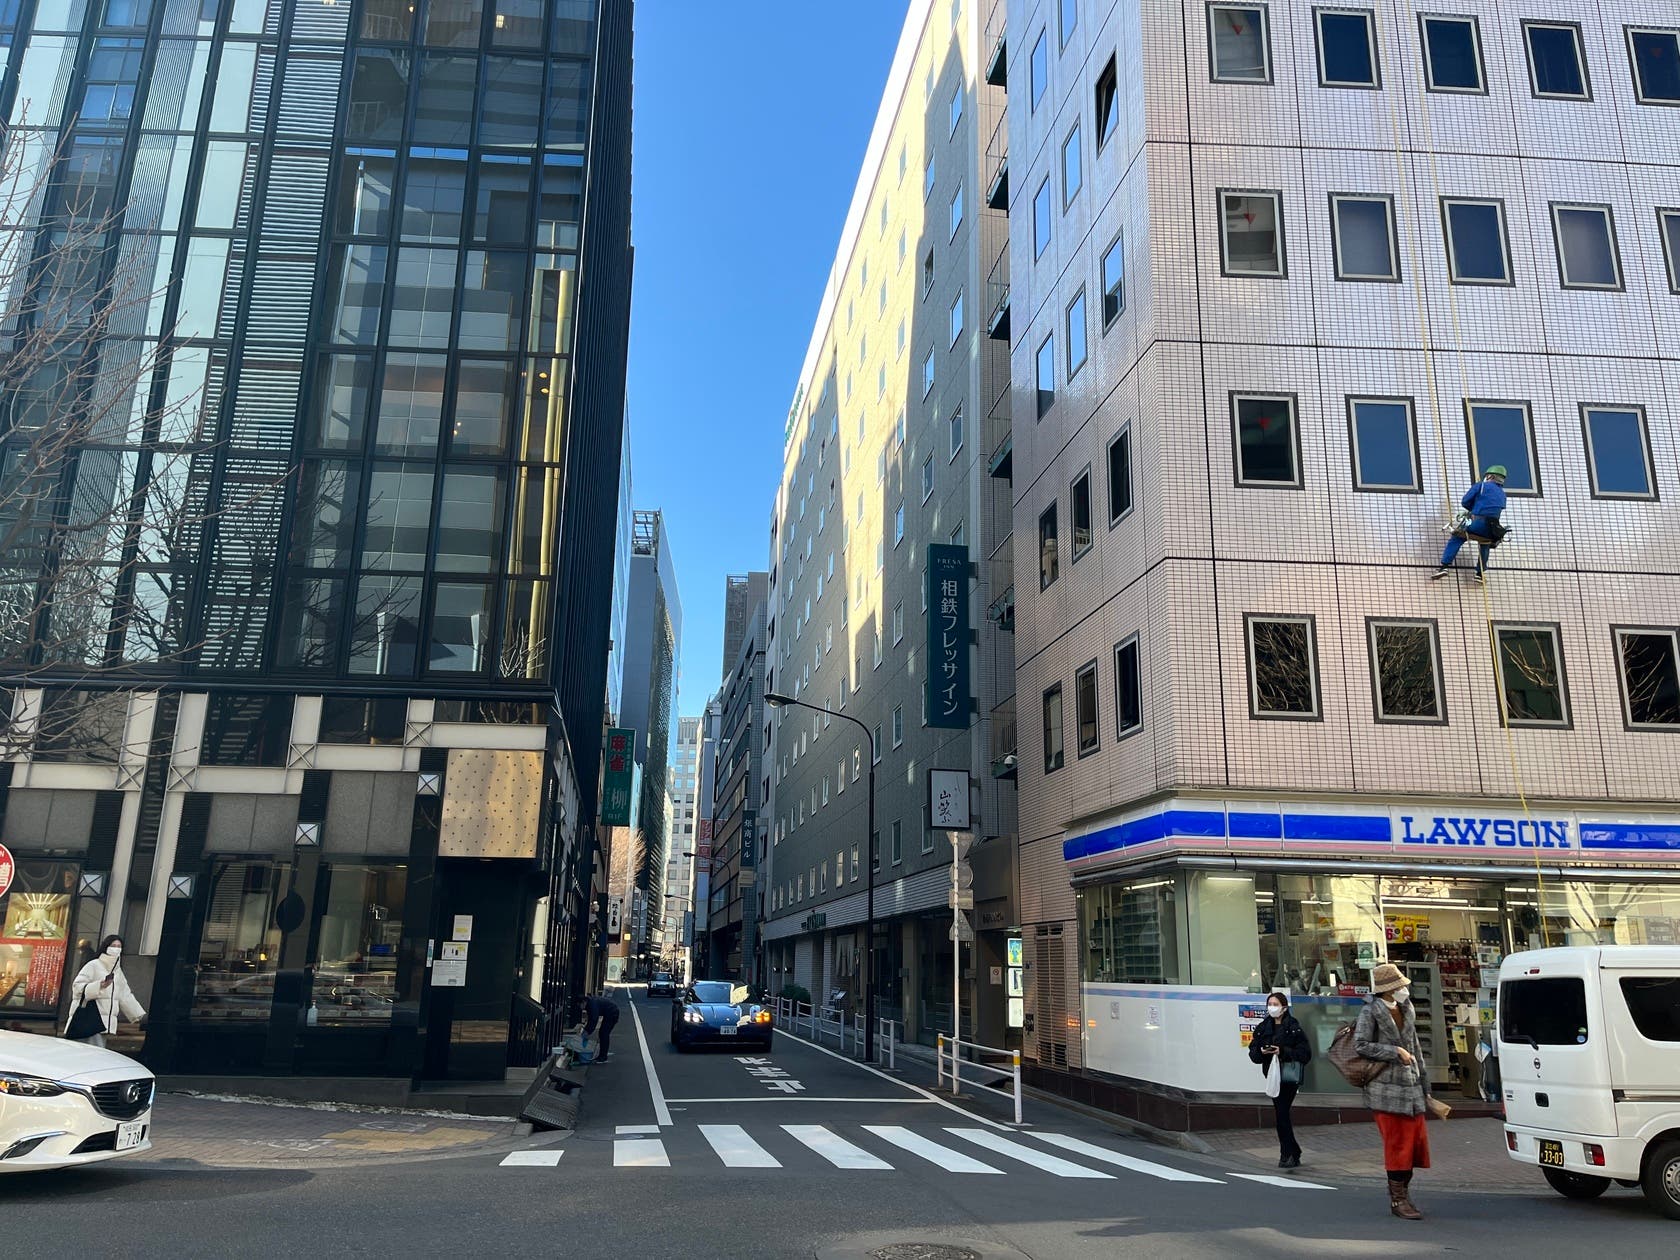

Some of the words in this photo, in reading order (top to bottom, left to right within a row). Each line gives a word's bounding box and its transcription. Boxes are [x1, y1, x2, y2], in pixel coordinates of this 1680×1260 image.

[941, 579, 958, 715] 相鉄フレッサイン
[1401, 817, 1570, 848] LAWSON
[1543, 1150, 1563, 1165] 33-03
